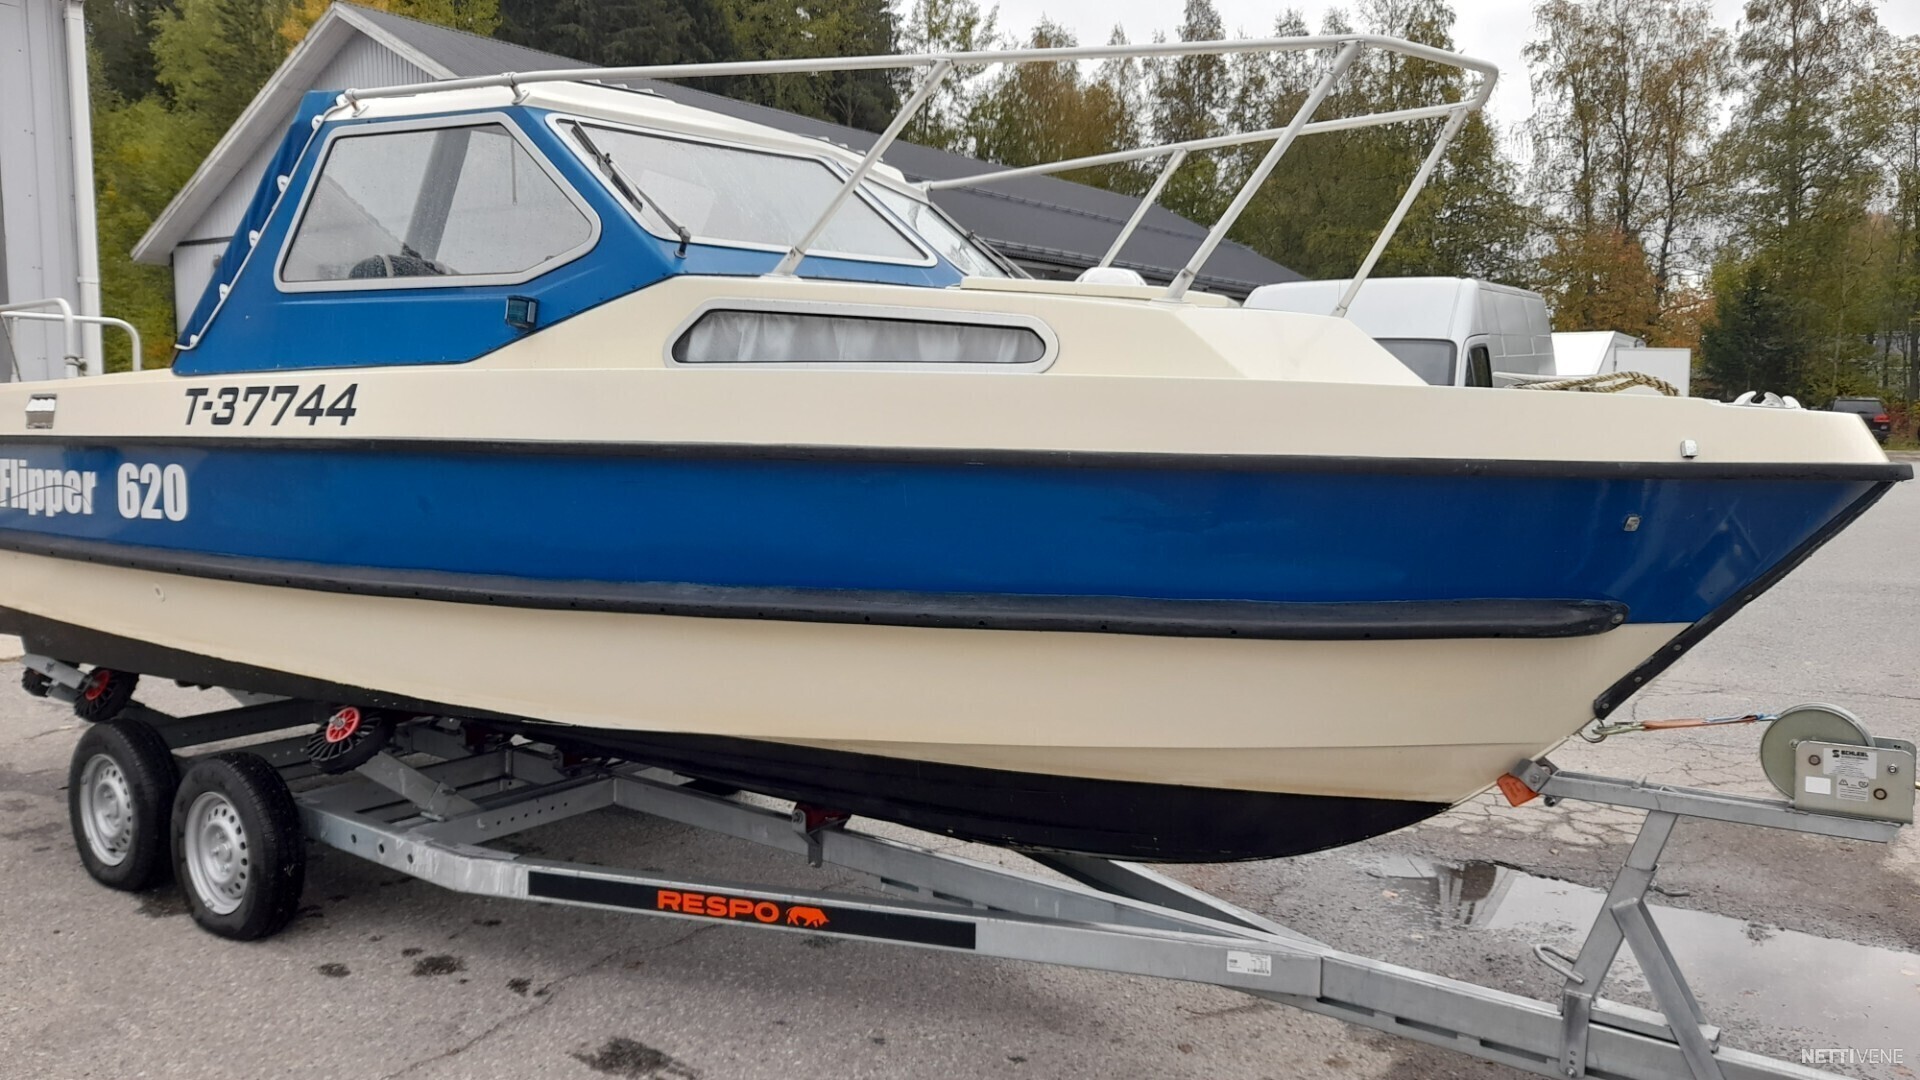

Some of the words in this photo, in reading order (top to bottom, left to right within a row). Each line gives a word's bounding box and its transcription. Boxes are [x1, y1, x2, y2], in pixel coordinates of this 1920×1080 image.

[185, 384, 358, 426] T-37744
[0, 458, 96, 517] Flipper
[117, 462, 188, 522] 620
[657, 889, 780, 923] RESPO
